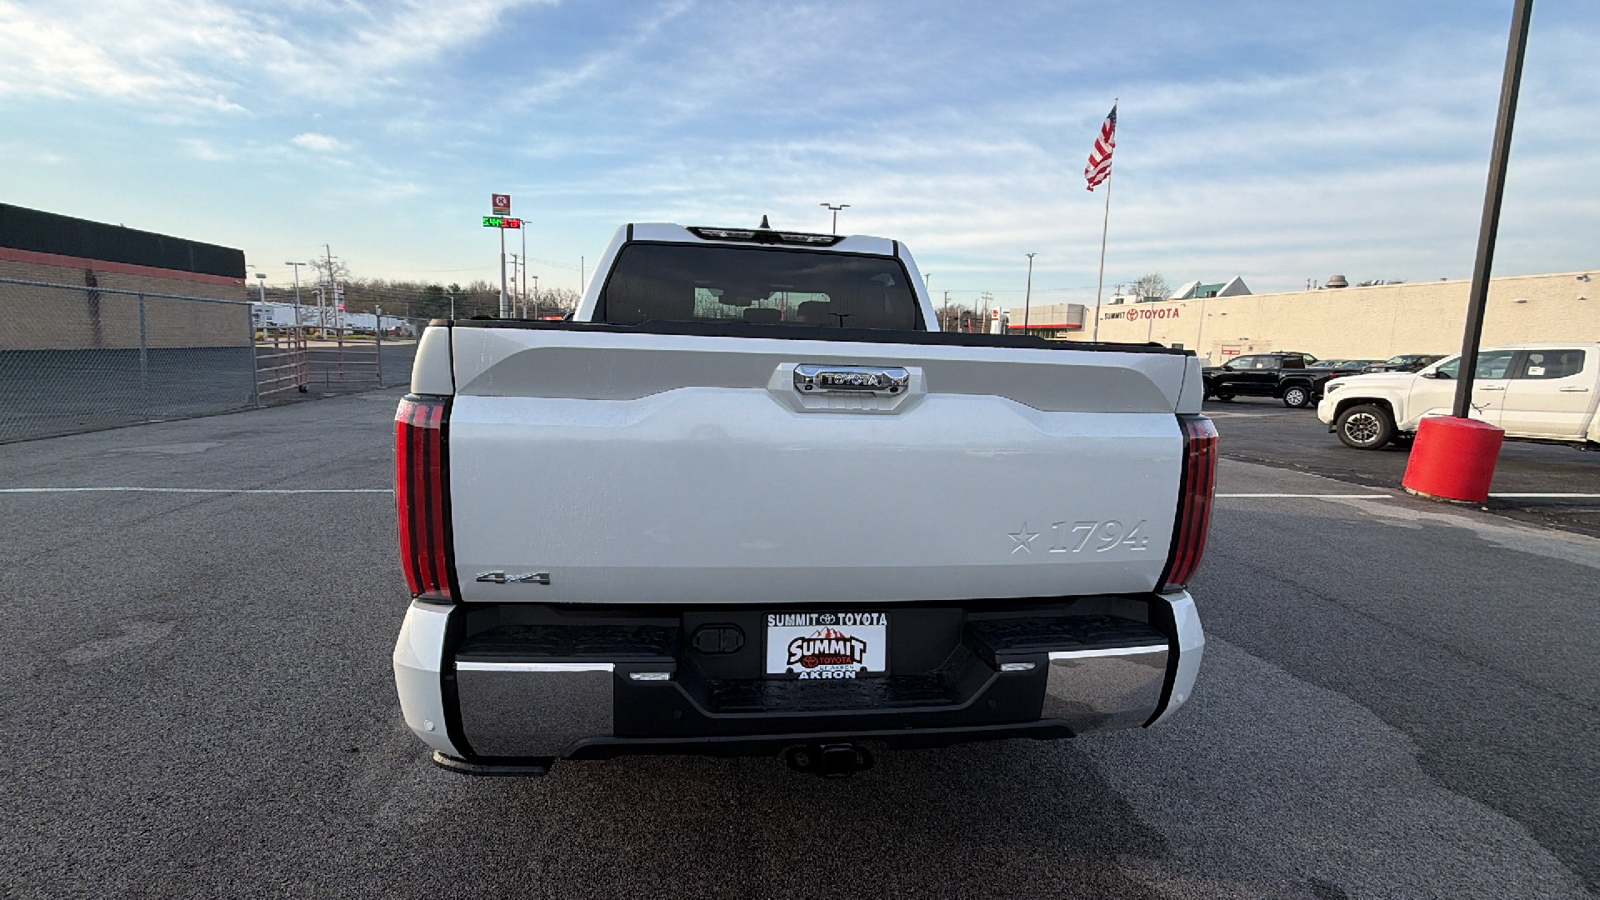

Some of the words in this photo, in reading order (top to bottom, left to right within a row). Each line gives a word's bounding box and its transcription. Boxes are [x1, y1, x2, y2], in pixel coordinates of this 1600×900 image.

[1104, 311, 1126, 320] SUMMIT
[1139, 308, 1180, 319] TOYOTA
[825, 373, 879, 386] TOYOTA
[1049, 519, 1149, 553] 1794
[767, 613, 819, 627] SUMMIT
[837, 612, 888, 626] TOYOTA
[787, 636, 867, 664] SUMMIT
[820, 656, 852, 664] TOYOTA
[798, 670, 856, 680] AKRON
